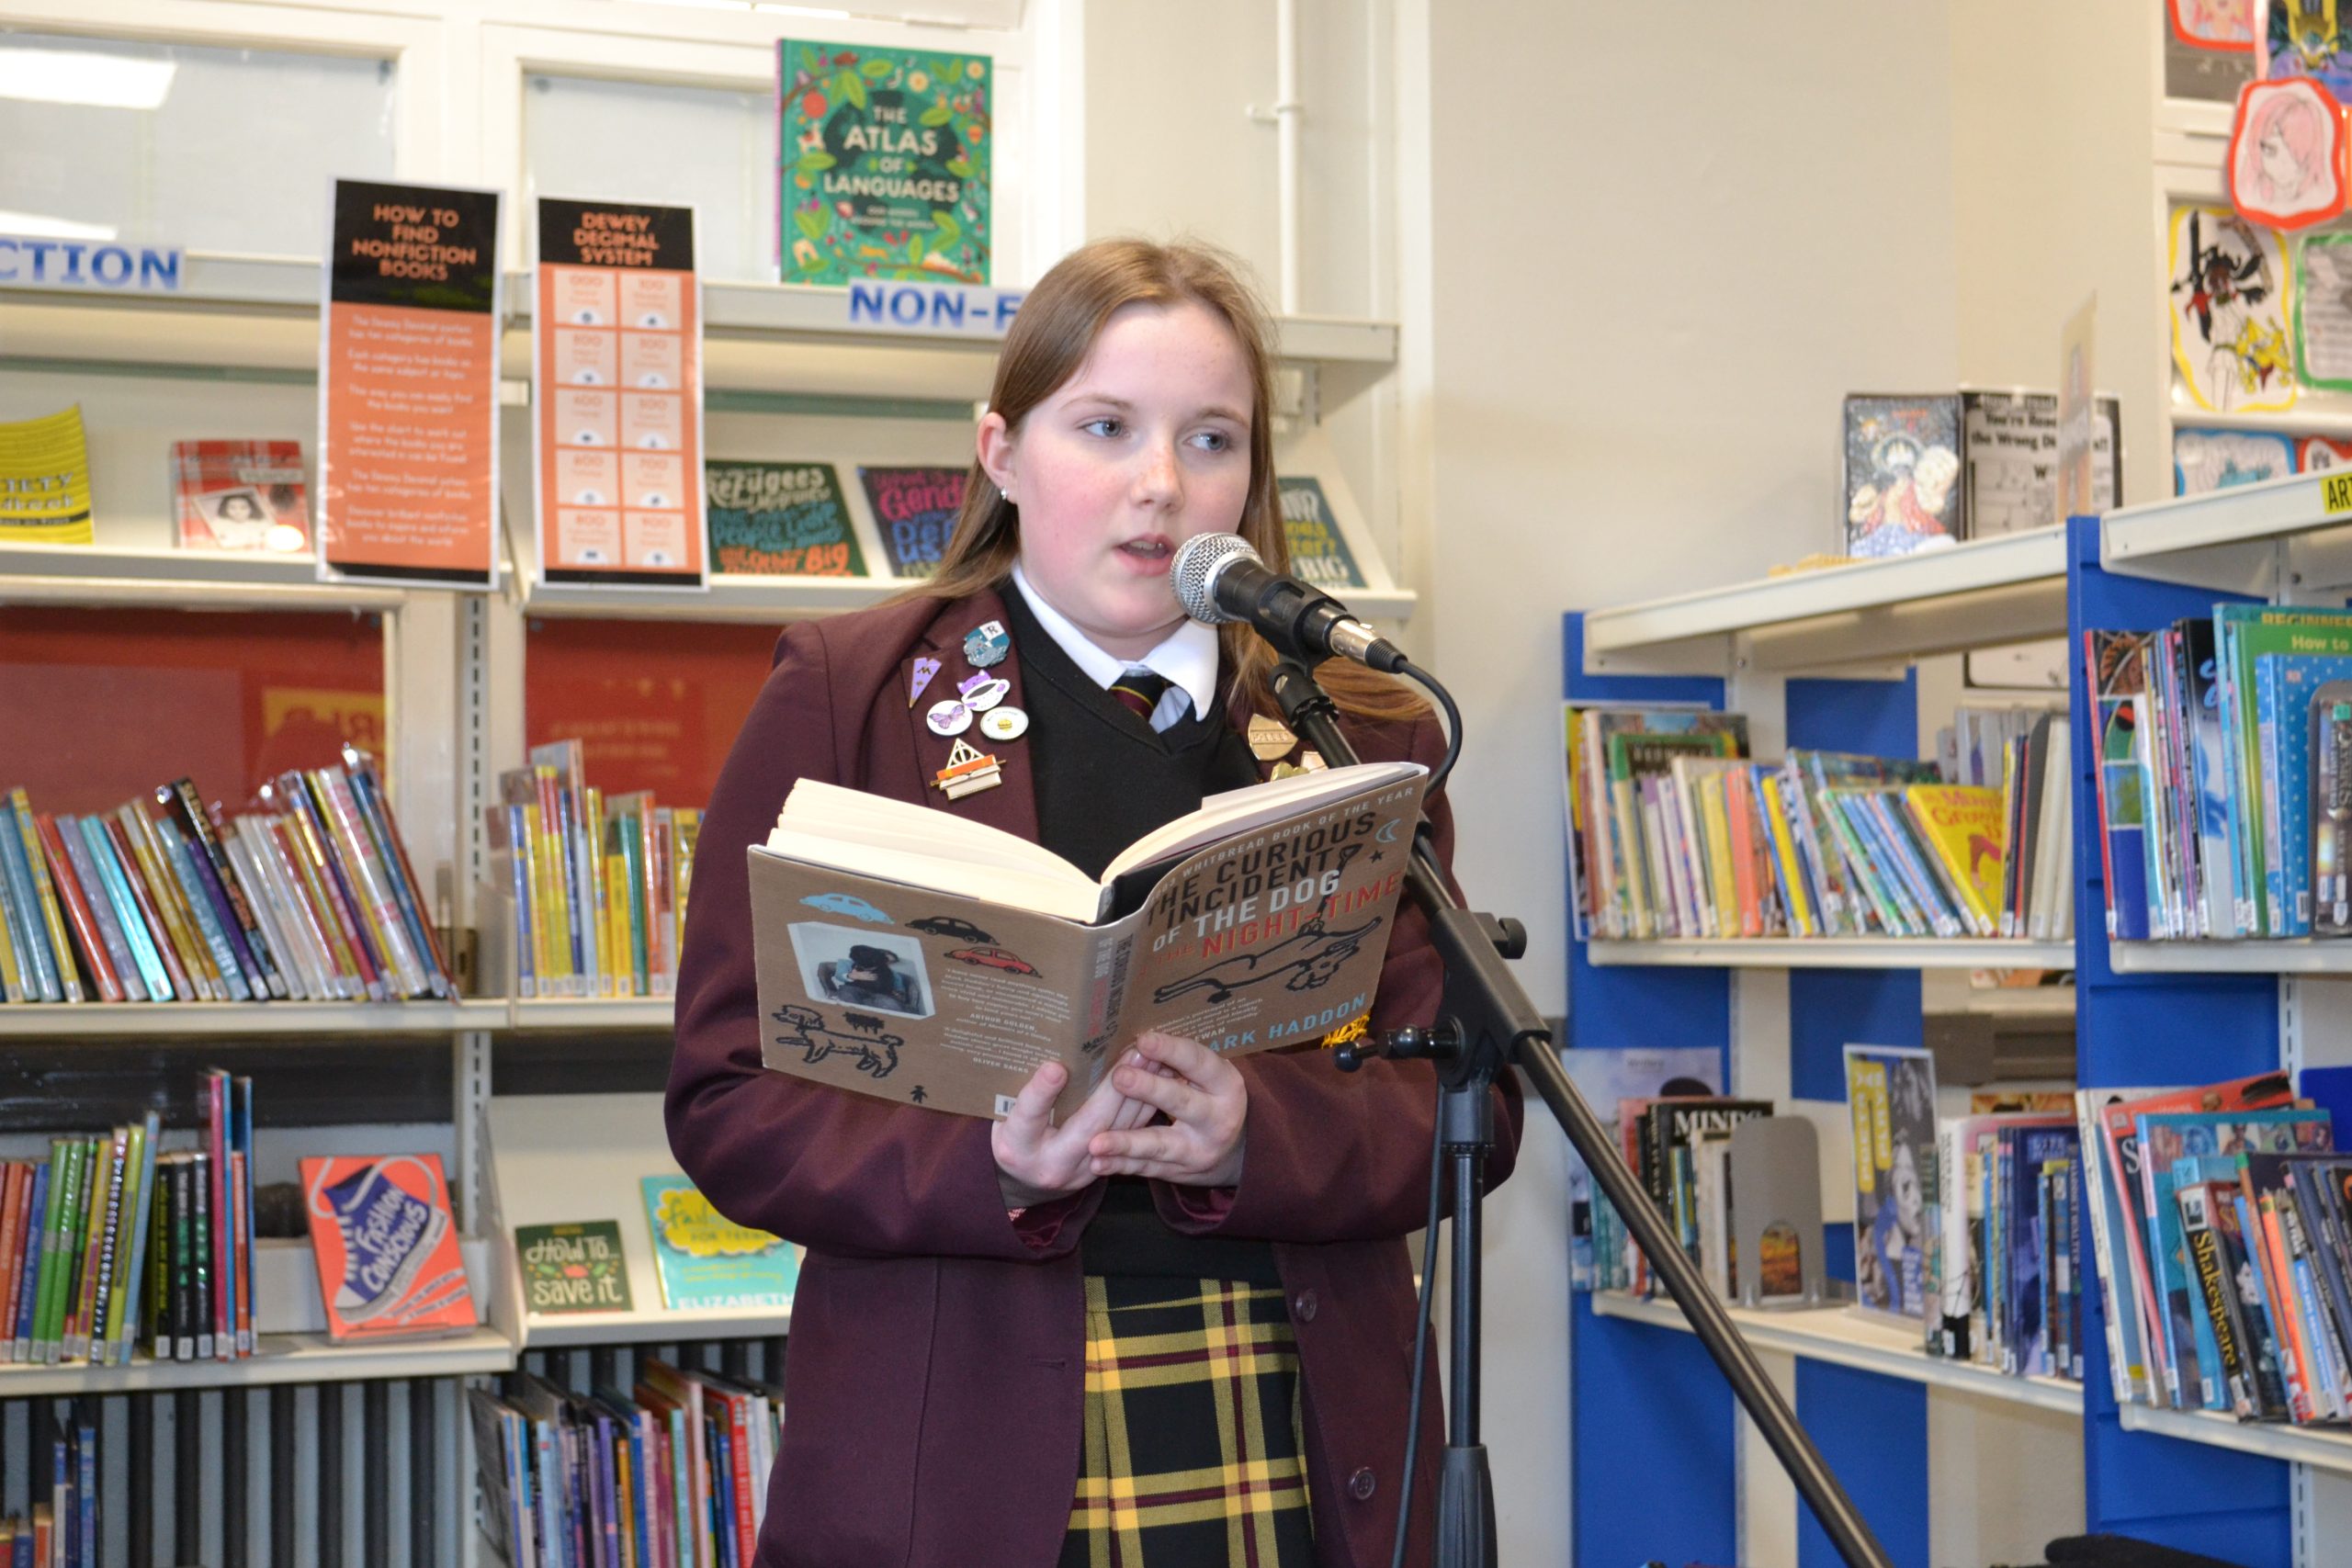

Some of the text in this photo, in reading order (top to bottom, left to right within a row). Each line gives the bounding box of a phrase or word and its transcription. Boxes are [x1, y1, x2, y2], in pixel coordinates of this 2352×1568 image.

[873, 106, 908, 123] THE
[843, 125, 937, 156] ATLAS
[879, 157, 903, 173] OF
[824, 173, 961, 203] LANGUAGES
[373, 203, 459, 228] HOW TO
[581, 212, 650, 231] DEWEY
[391, 226, 439, 244] FIND
[573, 228, 660, 250] DECIMAL
[352, 239, 477, 265] NONFICTION
[581, 247, 652, 266] SYSTEM
[379, 259, 448, 281] BOOKS
[849, 285, 1022, 331] NON-F
[1972, 431, 1992, 446] the
[1996, 431, 2038, 451] Wrong
[6, 471, 74, 493] IETY
[877, 474, 965, 522] Gend
[2291, 634, 2349, 652] How to
[1182, 786, 1414, 877] WHITBREAD BOOK OF THE YEAR
[1148, 811, 1377, 926] THE CURIOUS
[1166, 843, 1336, 930] INCIDENT
[1153, 869, 1341, 953] OF THE DOG
[1158, 945, 1194, 965] THE
[1201, 871, 1404, 960] NIGHT-TIME
[969, 1012, 1001, 1024] ARTHUR
[1208, 993, 1367, 1054] ARK HADDON
[972, 1056, 1029, 1074] OLIVER SACKS
[356, 1188, 409, 1255] FASHION
[669, 1196, 708, 1231] Fail
[360, 1201, 429, 1292] CONSCIOUS
[533, 1273, 625, 1306] save it
[677, 1292, 794, 1310] ELIZABETH
[2196, 1231, 2236, 1367] Shakespeare
